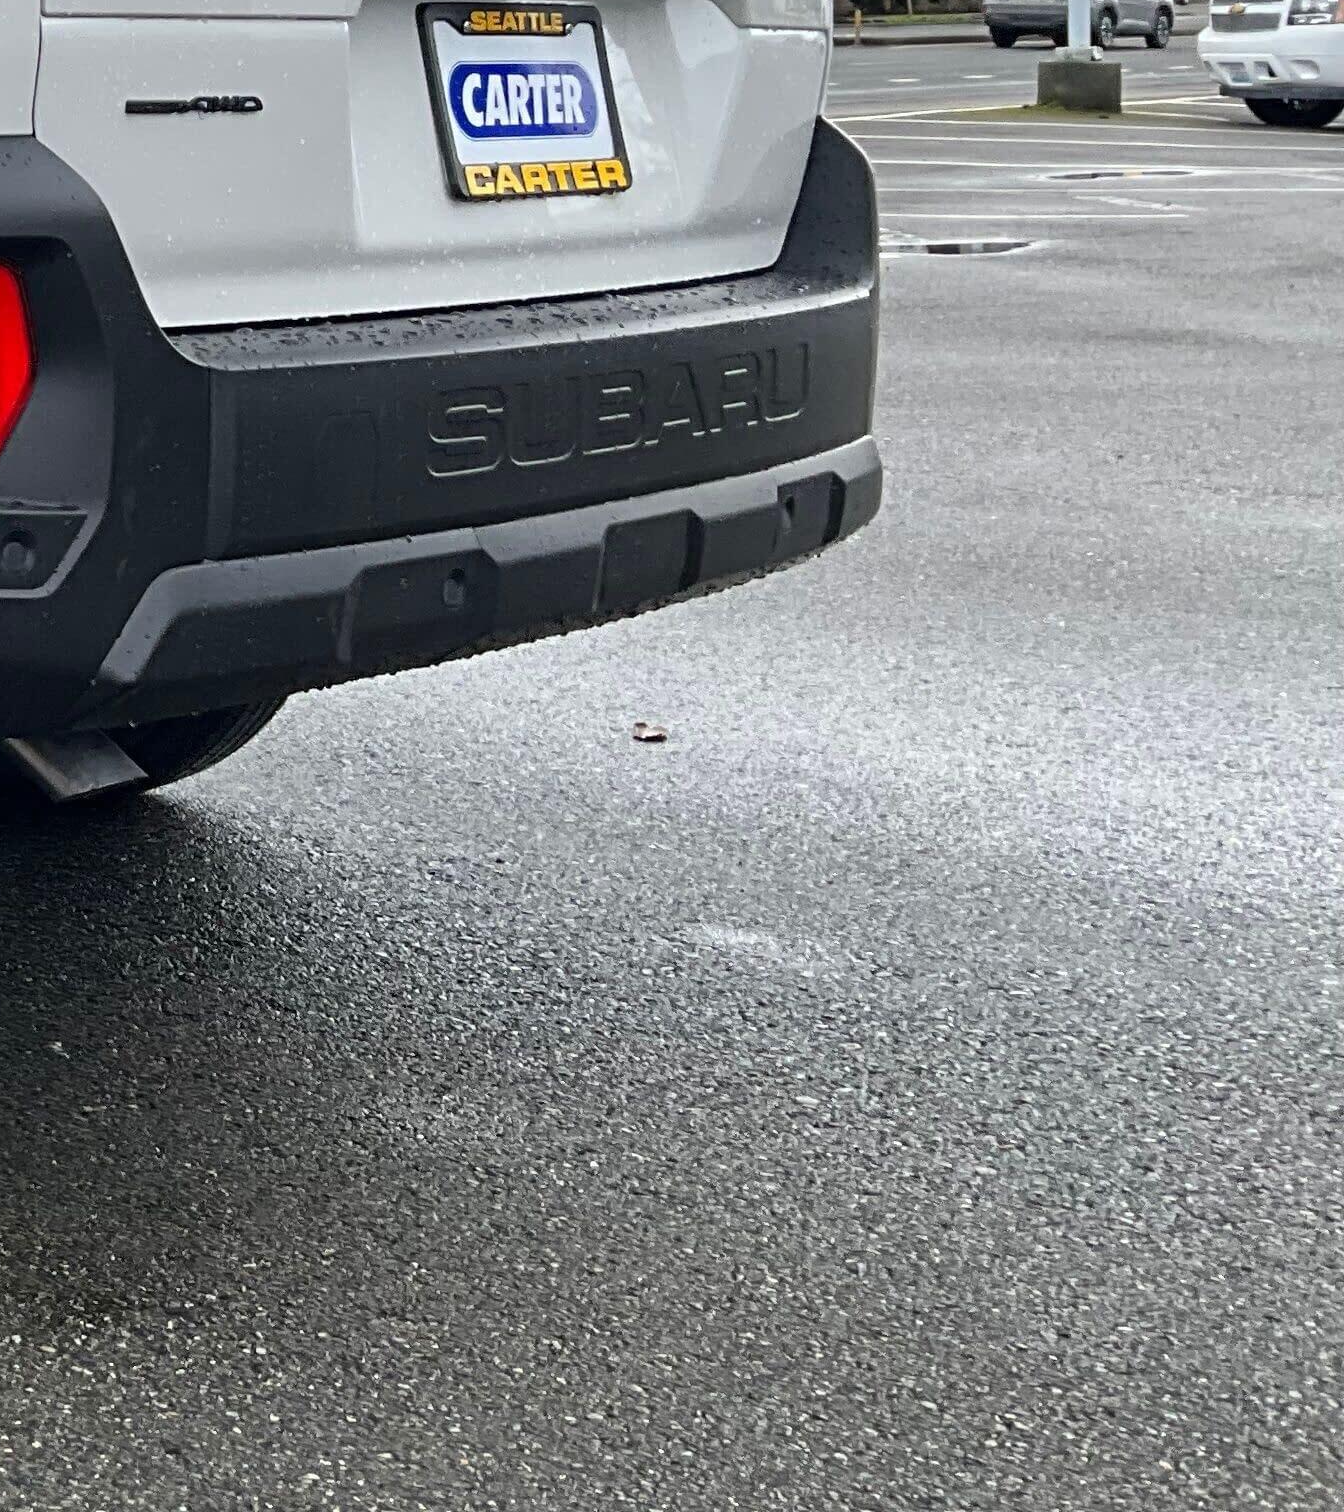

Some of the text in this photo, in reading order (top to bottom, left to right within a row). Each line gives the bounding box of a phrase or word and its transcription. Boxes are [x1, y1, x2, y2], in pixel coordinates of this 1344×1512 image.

[469, 10, 564, 33] SEATTLE
[462, 72, 586, 128] CARTER
[464, 159, 628, 196] CARTER
[425, 342, 810, 478] SUBARU
